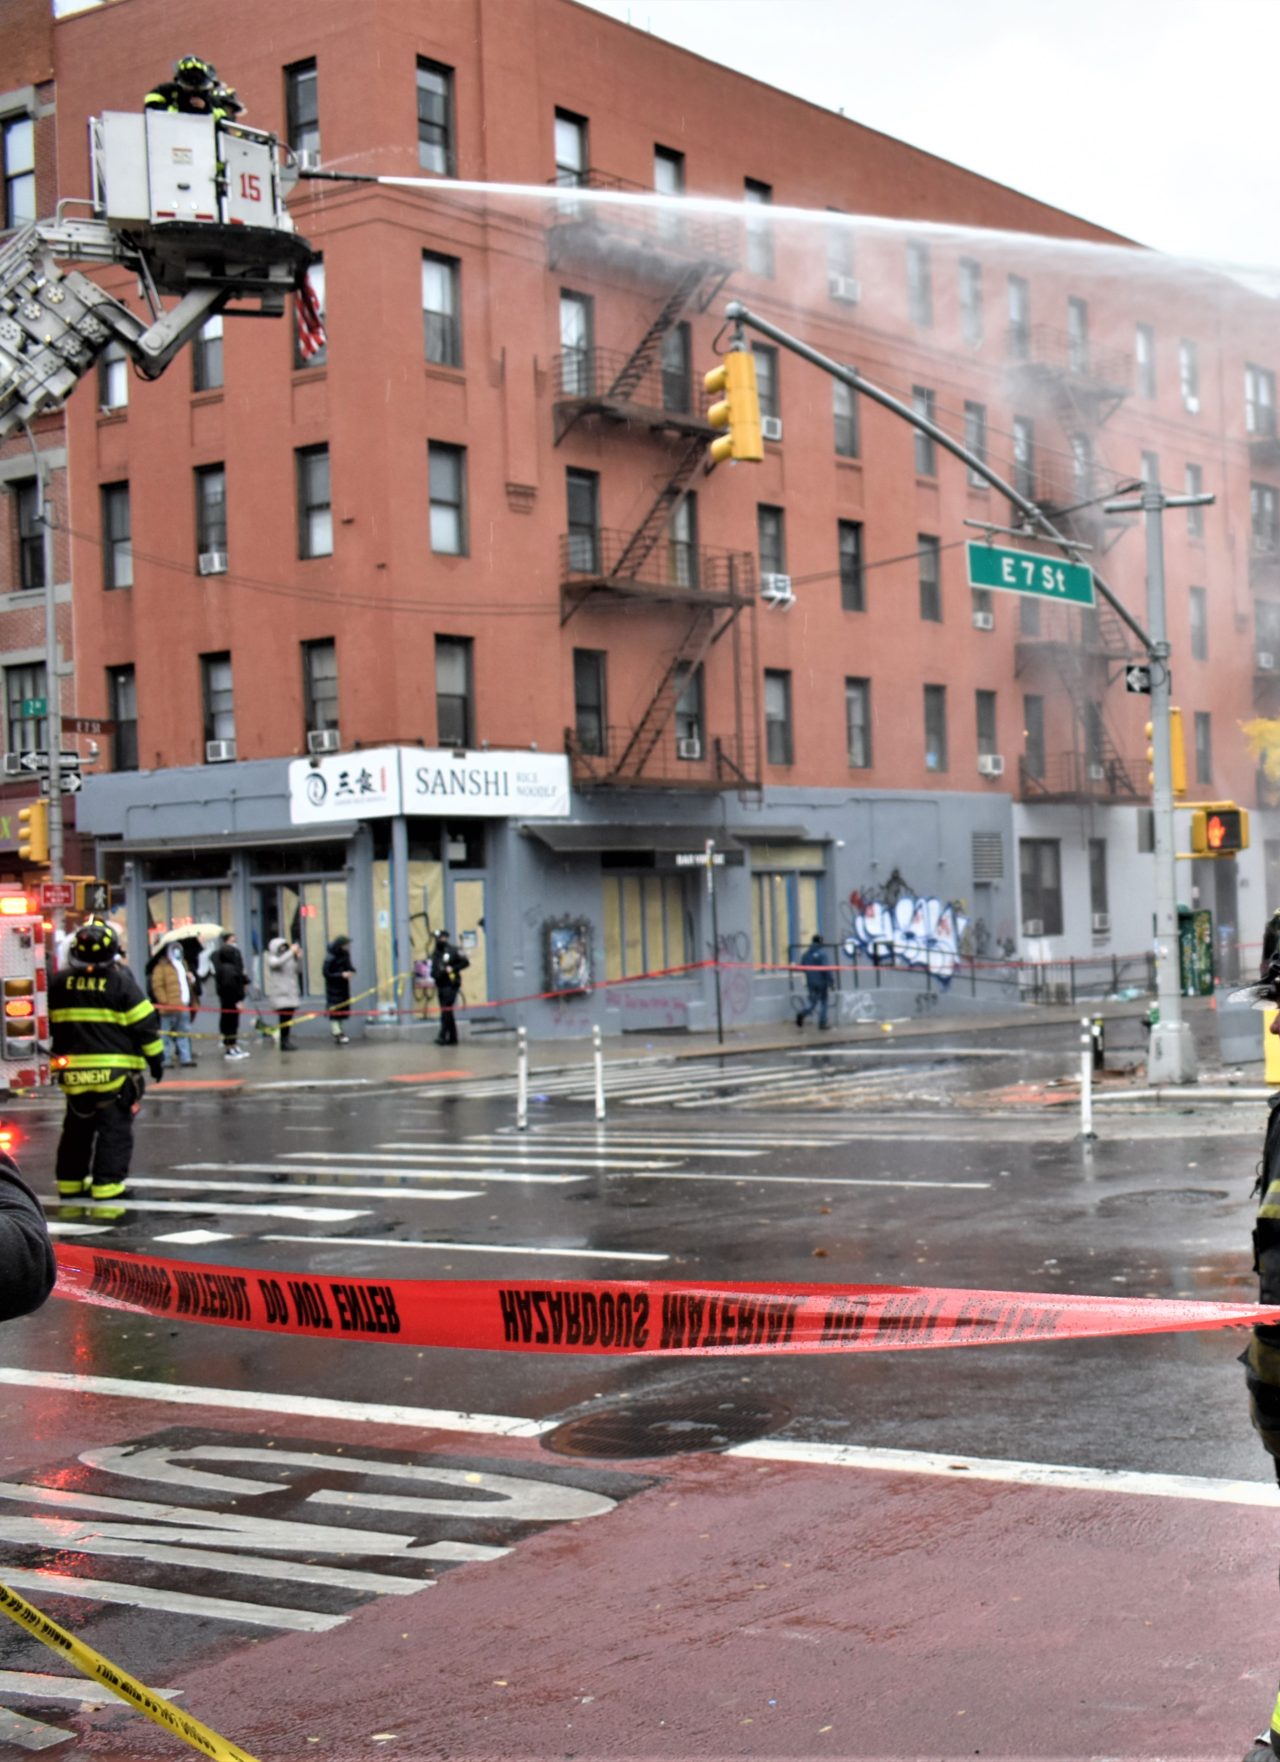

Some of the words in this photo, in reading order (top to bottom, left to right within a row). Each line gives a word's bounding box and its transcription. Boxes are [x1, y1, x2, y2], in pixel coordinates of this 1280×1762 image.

[240, 173, 262, 202] 15
[1001, 557, 1017, 583] E
[1020, 560, 1036, 586] 7
[1042, 563, 1067, 592] St
[416, 766, 509, 797] SANSHI
